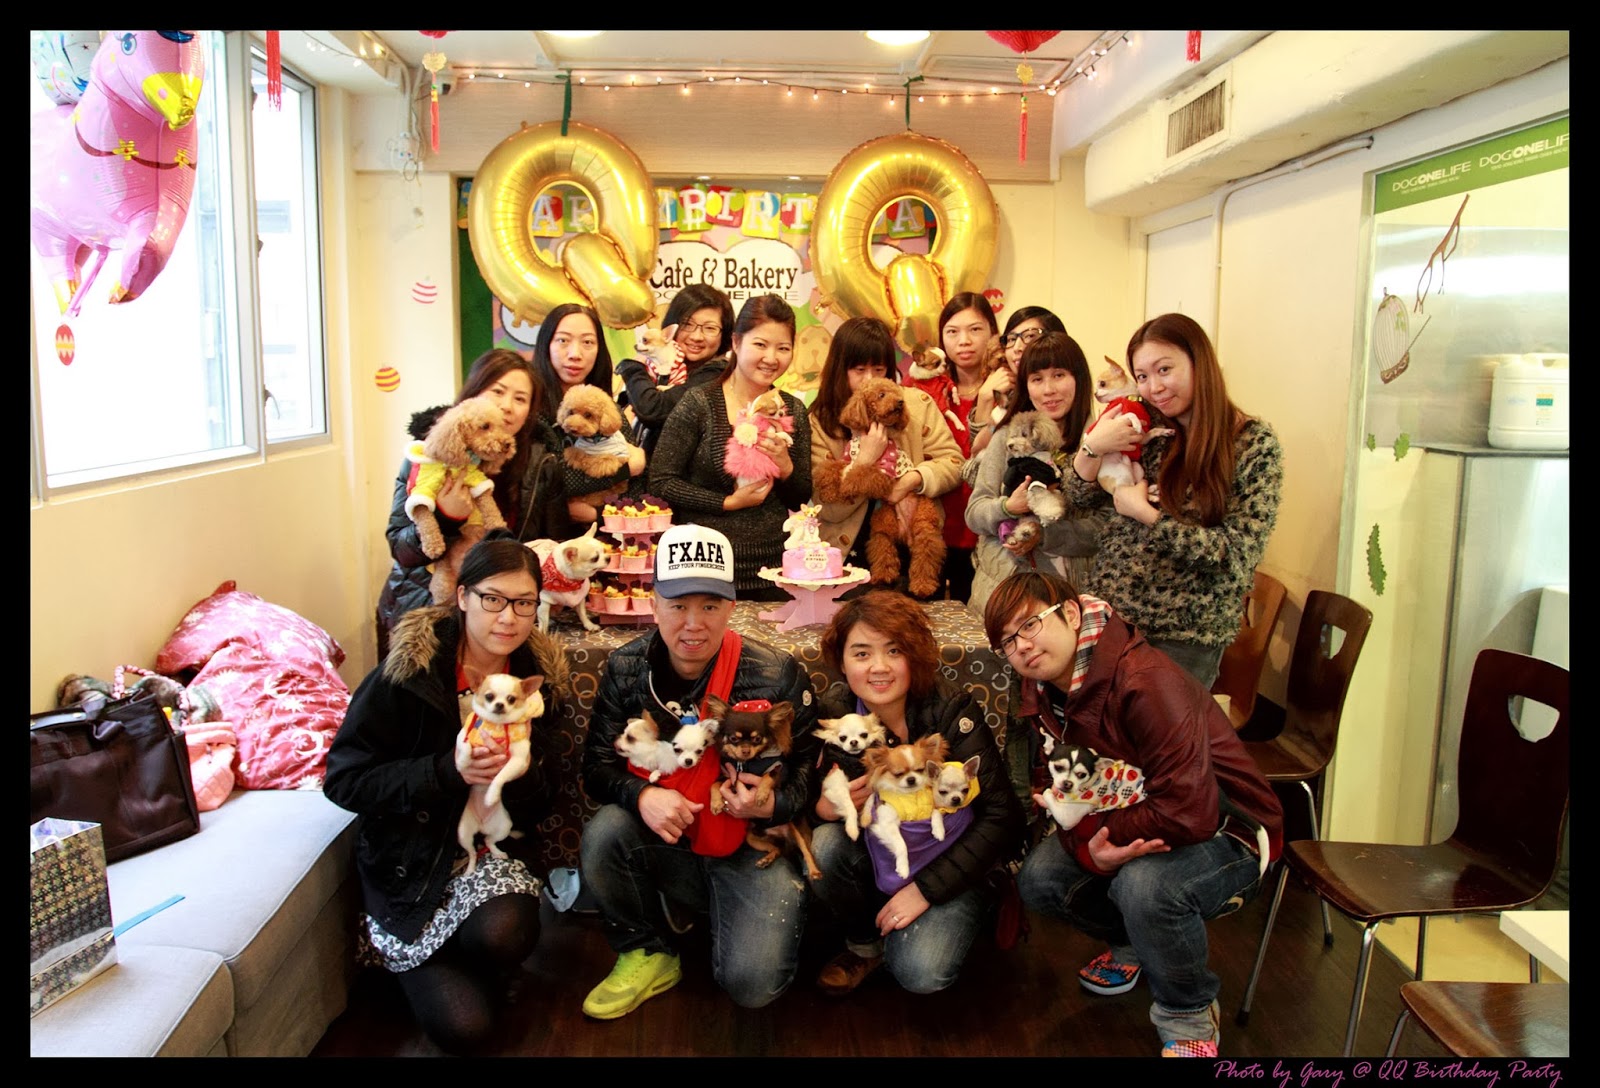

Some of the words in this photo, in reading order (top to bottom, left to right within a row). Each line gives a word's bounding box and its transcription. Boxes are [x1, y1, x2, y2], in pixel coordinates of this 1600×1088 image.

[1392, 161, 1472, 191] DOGONELIFE
[650, 257, 693, 289] Cafe
[701, 257, 718, 288] &
[724, 258, 798, 290] Bakery
[668, 541, 725, 565] FXAFA
